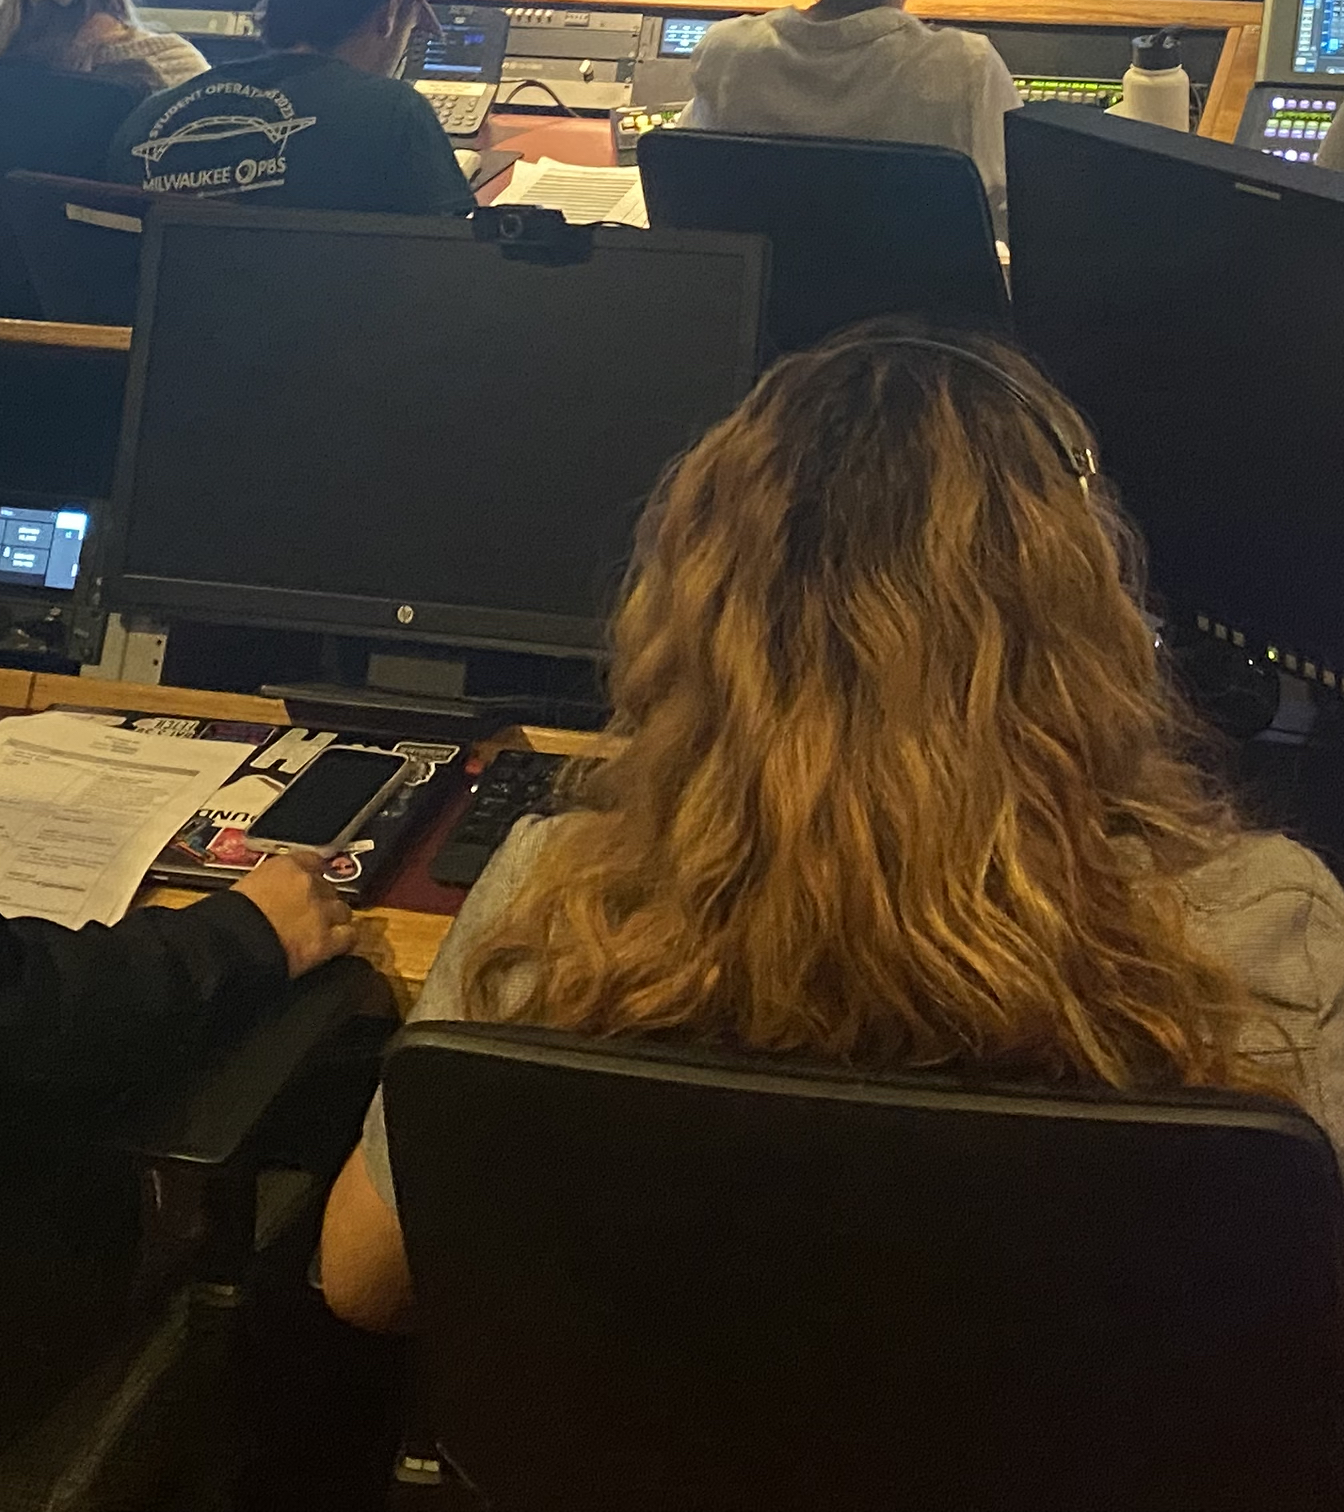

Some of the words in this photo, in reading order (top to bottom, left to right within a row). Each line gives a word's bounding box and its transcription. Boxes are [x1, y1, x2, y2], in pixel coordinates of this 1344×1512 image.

[149, 89, 203, 138] STUDENT
[142, 166, 232, 192] MILWAUKEE
[257, 156, 288, 177] PBS
[198, 808, 256, 824] UND
